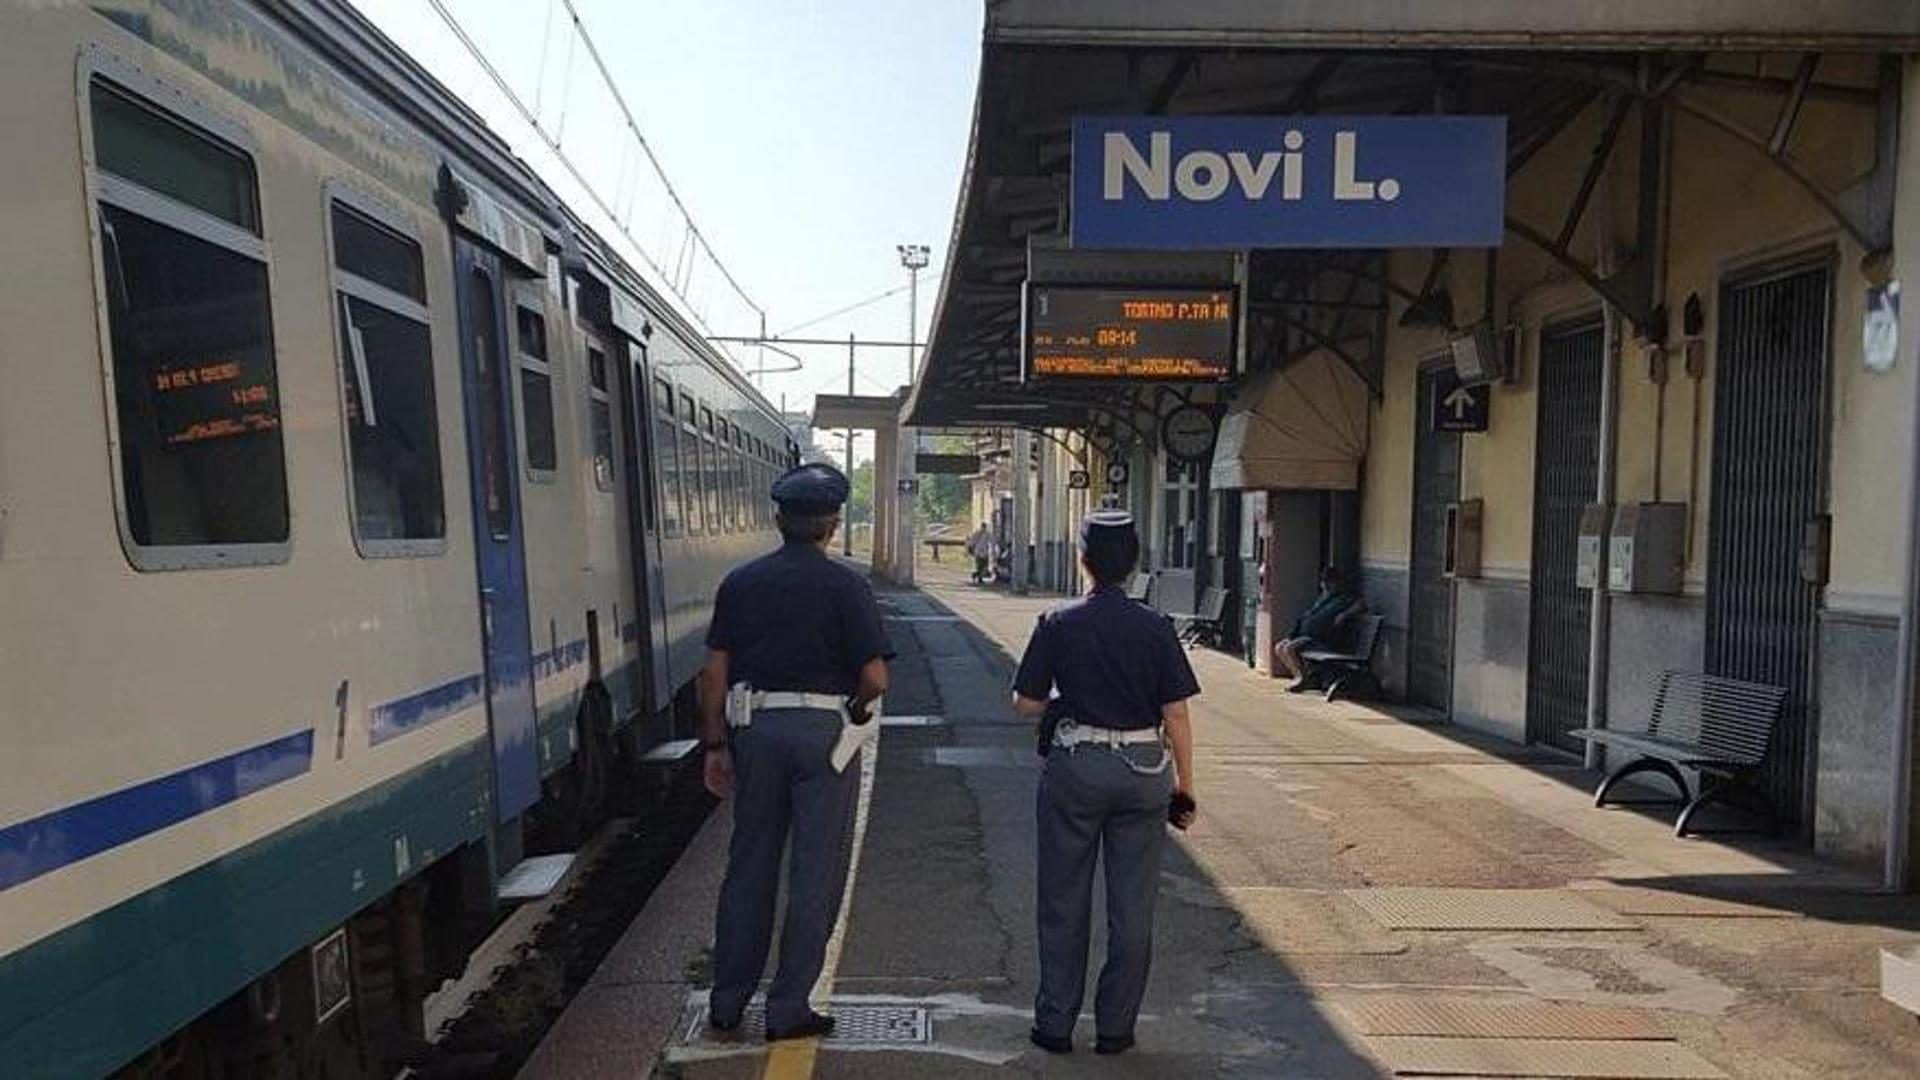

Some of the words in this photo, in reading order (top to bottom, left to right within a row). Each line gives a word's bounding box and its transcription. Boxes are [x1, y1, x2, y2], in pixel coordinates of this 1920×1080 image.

[1103, 130, 1304, 200] Novi
[1333, 131, 1400, 201] L.
[1122, 301, 1174, 319] TORINO
